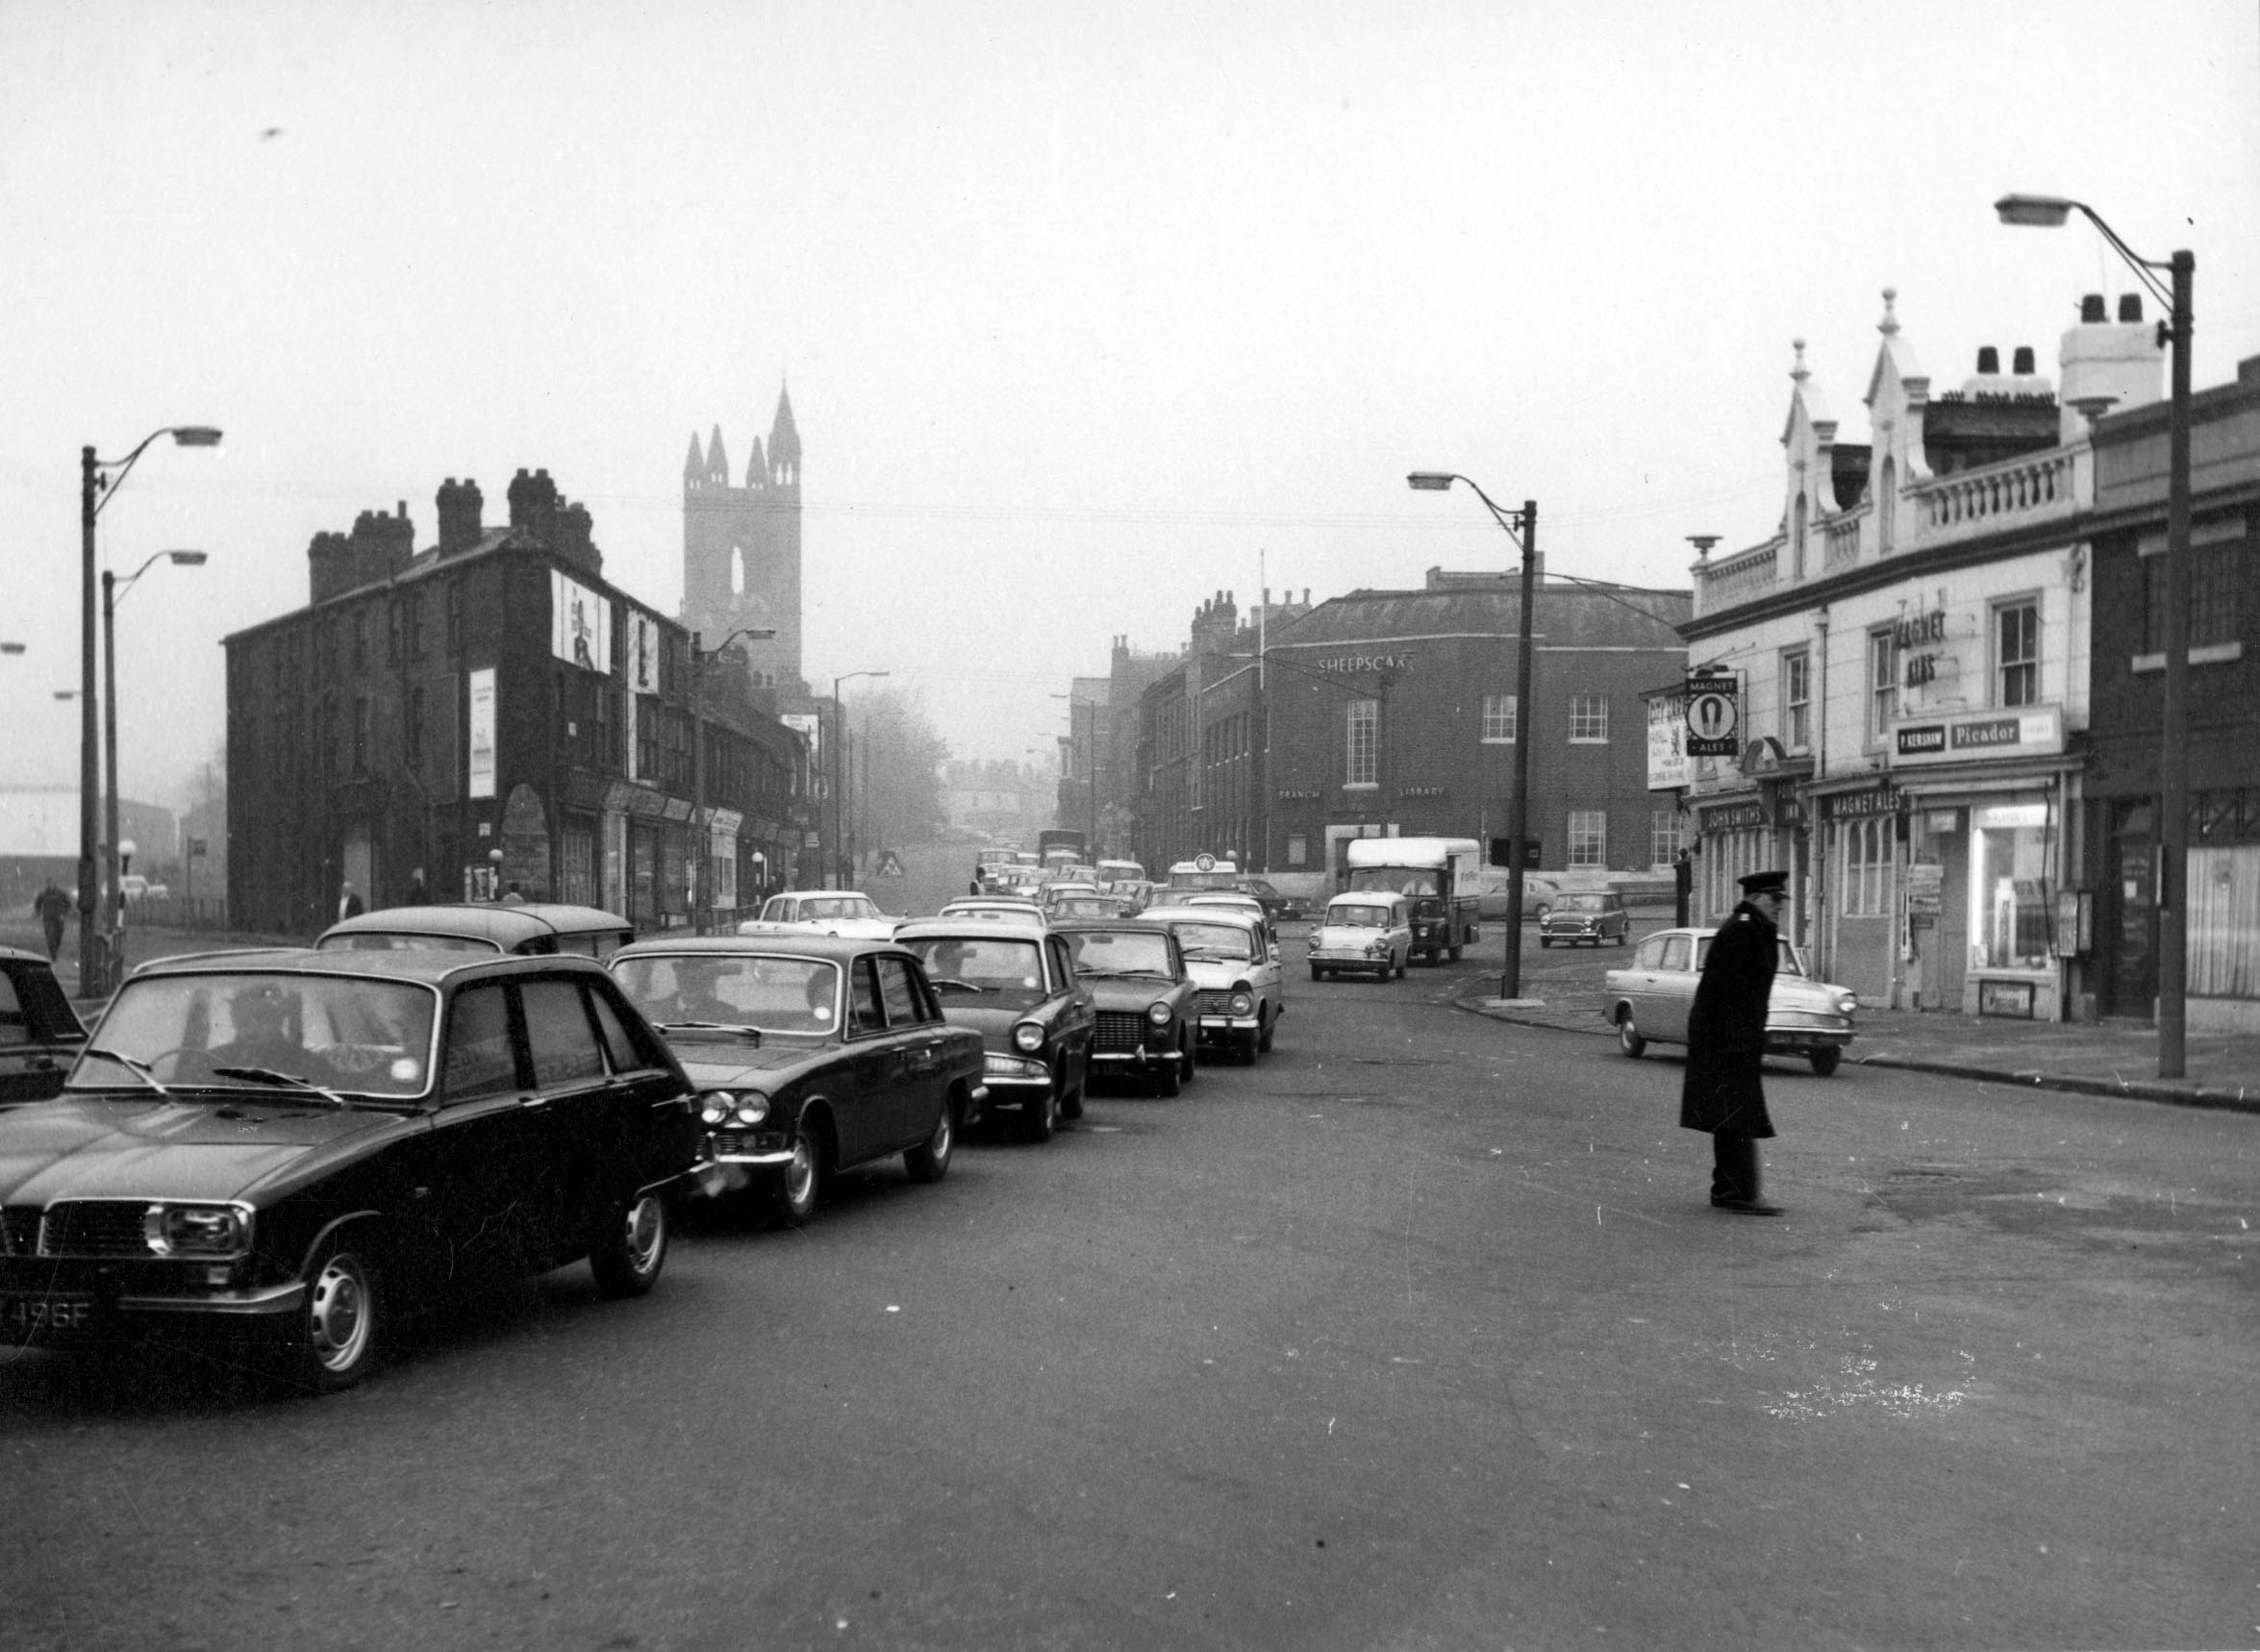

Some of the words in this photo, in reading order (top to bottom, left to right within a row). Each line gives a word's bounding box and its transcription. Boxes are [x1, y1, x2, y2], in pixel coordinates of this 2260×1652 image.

[1691, 681, 1734, 691] MAGNET
[1956, 723, 2016, 745] Picador
[1699, 743, 1724, 752] ALES
[1398, 787, 1444, 797] LIBRARY
[1833, 793, 1874, 815] MAGNET
[1875, 789, 1900, 811] ALES
